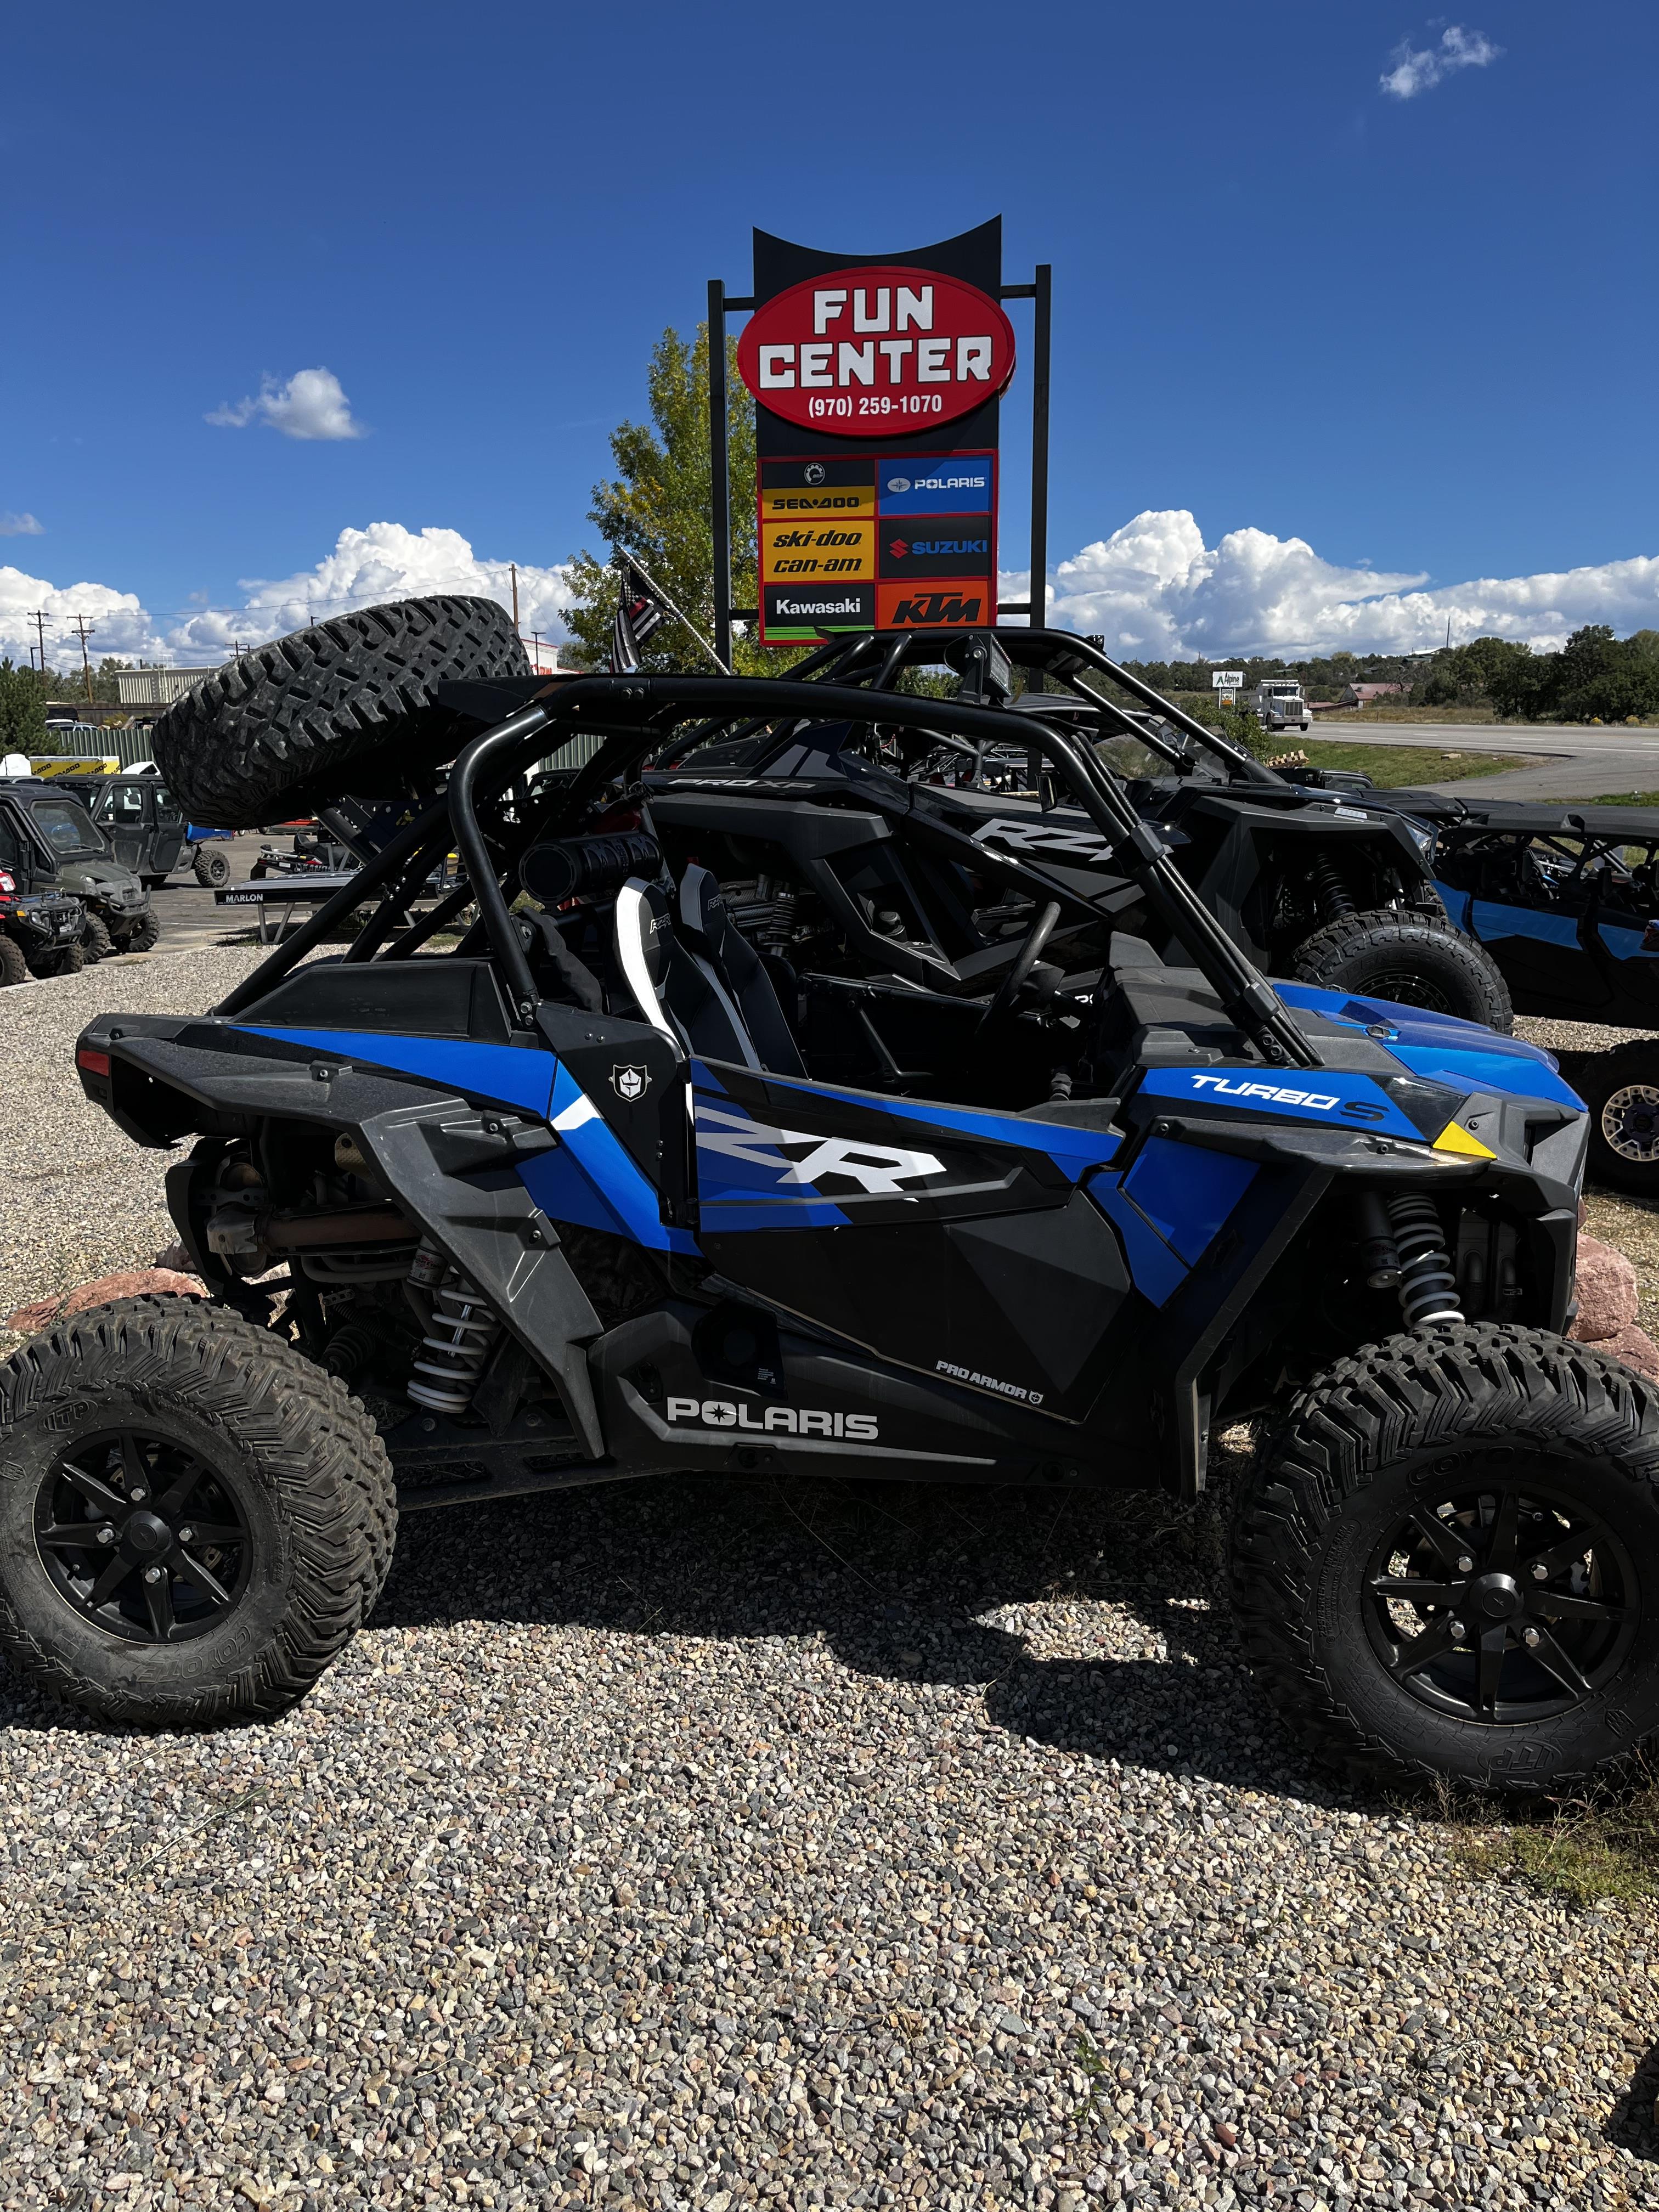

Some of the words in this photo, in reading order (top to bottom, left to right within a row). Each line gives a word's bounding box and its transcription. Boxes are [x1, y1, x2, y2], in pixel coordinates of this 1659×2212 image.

[815, 286, 934, 334] FUN
[759, 336, 992, 389] CENTER
[809, 396, 853, 417] (970)
[859, 394, 942, 415] 259-1070
[915, 477, 985, 489] POLARIS
[773, 529, 862, 548] ski-doo
[912, 539, 988, 555] SUZUKI
[774, 557, 862, 573] can-am
[776, 598, 861, 615] Kawasaki
[892, 592, 983, 624] KTM
[1224, 672, 1239, 686] Alpine
[225, 894, 263, 902] MARLON
[1191, 1074, 1341, 1110] TURBO
[1338, 1101, 1391, 1121] S
[936, 1360, 970, 1380] PRO
[969, 1372, 1027, 1400] ARMOR
[44, 1400, 89, 1433] ITP
[667, 1397, 878, 1440] POLARIS
[137, 1625, 252, 1683] COYOTE
[1488, 1743, 1554, 1771] ITP
